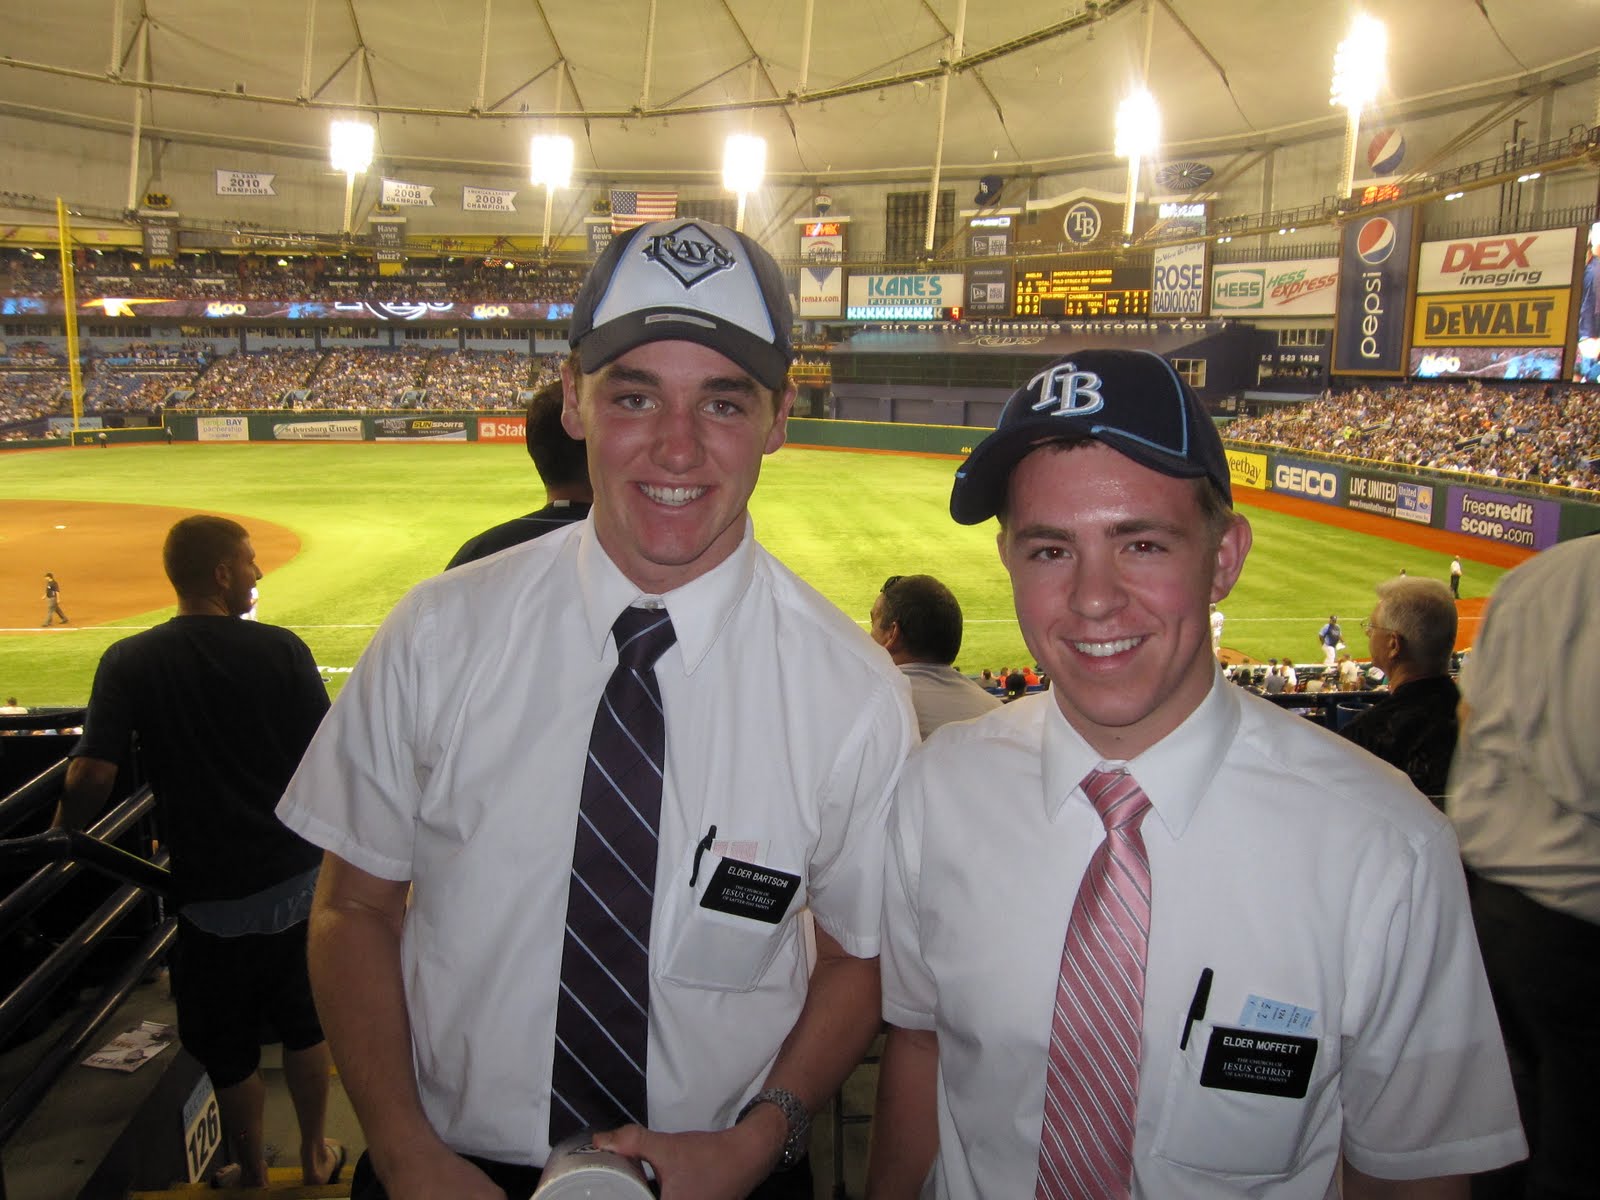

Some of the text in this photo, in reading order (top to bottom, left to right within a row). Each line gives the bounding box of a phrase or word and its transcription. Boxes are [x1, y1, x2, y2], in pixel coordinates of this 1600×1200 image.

[220, 186, 268, 194] CHAMPIONS
[230, 179, 260, 188] 2010
[386, 196, 428, 206] CHAMPIONS
[394, 189, 421, 199] 2008
[475, 195, 504, 205] 2008
[466, 202, 510, 211] CHAMPIONS
[593, 225, 609, 233] Fast
[1070, 211, 1095, 238] TB
[377, 252, 400, 260] buzz?
[1440, 236, 1539, 274] DEX
[869, 276, 942, 296] KANE'S
[1154, 264, 1202, 290] ROSE
[1267, 269, 1307, 288] HESS
[1459, 269, 1543, 287] imaging
[801, 294, 839, 302] remax.com
[1217, 282, 1260, 298] HESS
[1154, 290, 1201, 312] RADIOLOGY
[1361, 272, 1383, 358] pepsi
[1027, 362, 1105, 417] TB
[329, 423, 358, 433] Times
[497, 423, 526, 437] Stat
[1229, 456, 1261, 481] eetbay
[1276, 465, 1337, 498] GEICO
[1350, 476, 1397, 502] LIVE UNITED
[1399, 485, 1416, 498] United
[1405, 496, 1416, 510] Way
[1462, 494, 1533, 525] freecredit
[1461, 516, 1534, 545] score.com
[727, 865, 789, 889] ELDER BARTSCHI
[722, 887, 776, 906] JESUS CHRIST
[1223, 1036, 1301, 1055] ELDER MOFFETT
[1223, 1062, 1293, 1078] JESUS CHRIST
[189, 1100, 218, 1178] 126
